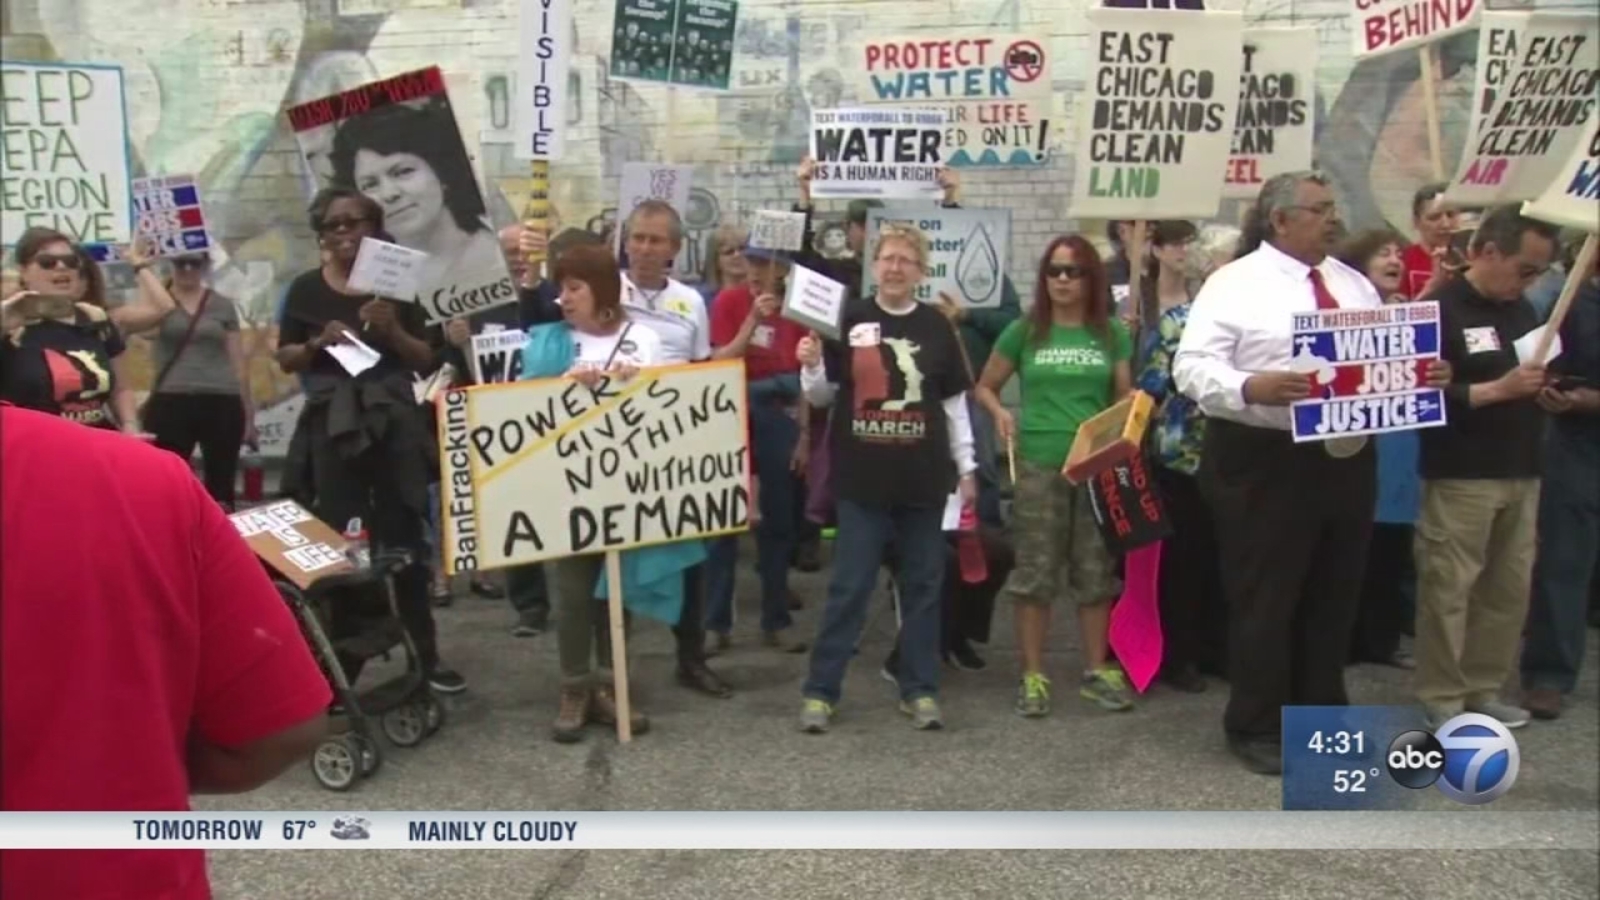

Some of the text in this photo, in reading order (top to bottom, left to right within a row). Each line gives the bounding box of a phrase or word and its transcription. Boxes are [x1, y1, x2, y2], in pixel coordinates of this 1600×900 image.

[1365, 0, 1475, 50] BEHIND
[866, 39, 993, 71] PROTECT
[1100, 31, 1174, 64] EAST
[1523, 35, 1587, 67] EAST
[870, 66, 1011, 99] WATER
[1097, 66, 1214, 99] CHICAGO
[978, 103, 1029, 124] LIFE
[1092, 99, 1225, 132] DEMANDS
[1493, 98, 1595, 128] DEMANDS
[4, 128, 88, 172] EPA
[815, 128, 941, 163] WATER
[982, 126, 1006, 147] ON
[1090, 133, 1184, 164] CLEAN
[1477, 129, 1558, 156] CLEAN
[815, 166, 829, 181] IS
[833, 166, 843, 181] A
[847, 166, 896, 181] HUMAN
[1088, 167, 1160, 198] LAND
[1460, 158, 1509, 185] AIR
[919, 219, 942, 231] on
[434, 277, 514, 320] Cáceres
[1294, 314, 1320, 331] TEXT
[1322, 309, 1391, 328] WATERFORALL
[1333, 325, 1416, 362] WATER
[1356, 359, 1418, 395] JOBS
[471, 374, 622, 467] POWER
[556, 379, 680, 459] GIVES
[852, 419, 926, 435] MARCH
[1315, 395, 1418, 434] JUSTICE
[565, 384, 737, 494] NOTHING
[445, 389, 477, 573] BanFracking
[626, 446, 747, 495] WITHOUT
[1115, 466, 1131, 488] for
[504, 485, 749, 557] A DEMAND
[289, 542, 341, 570] LIFE
